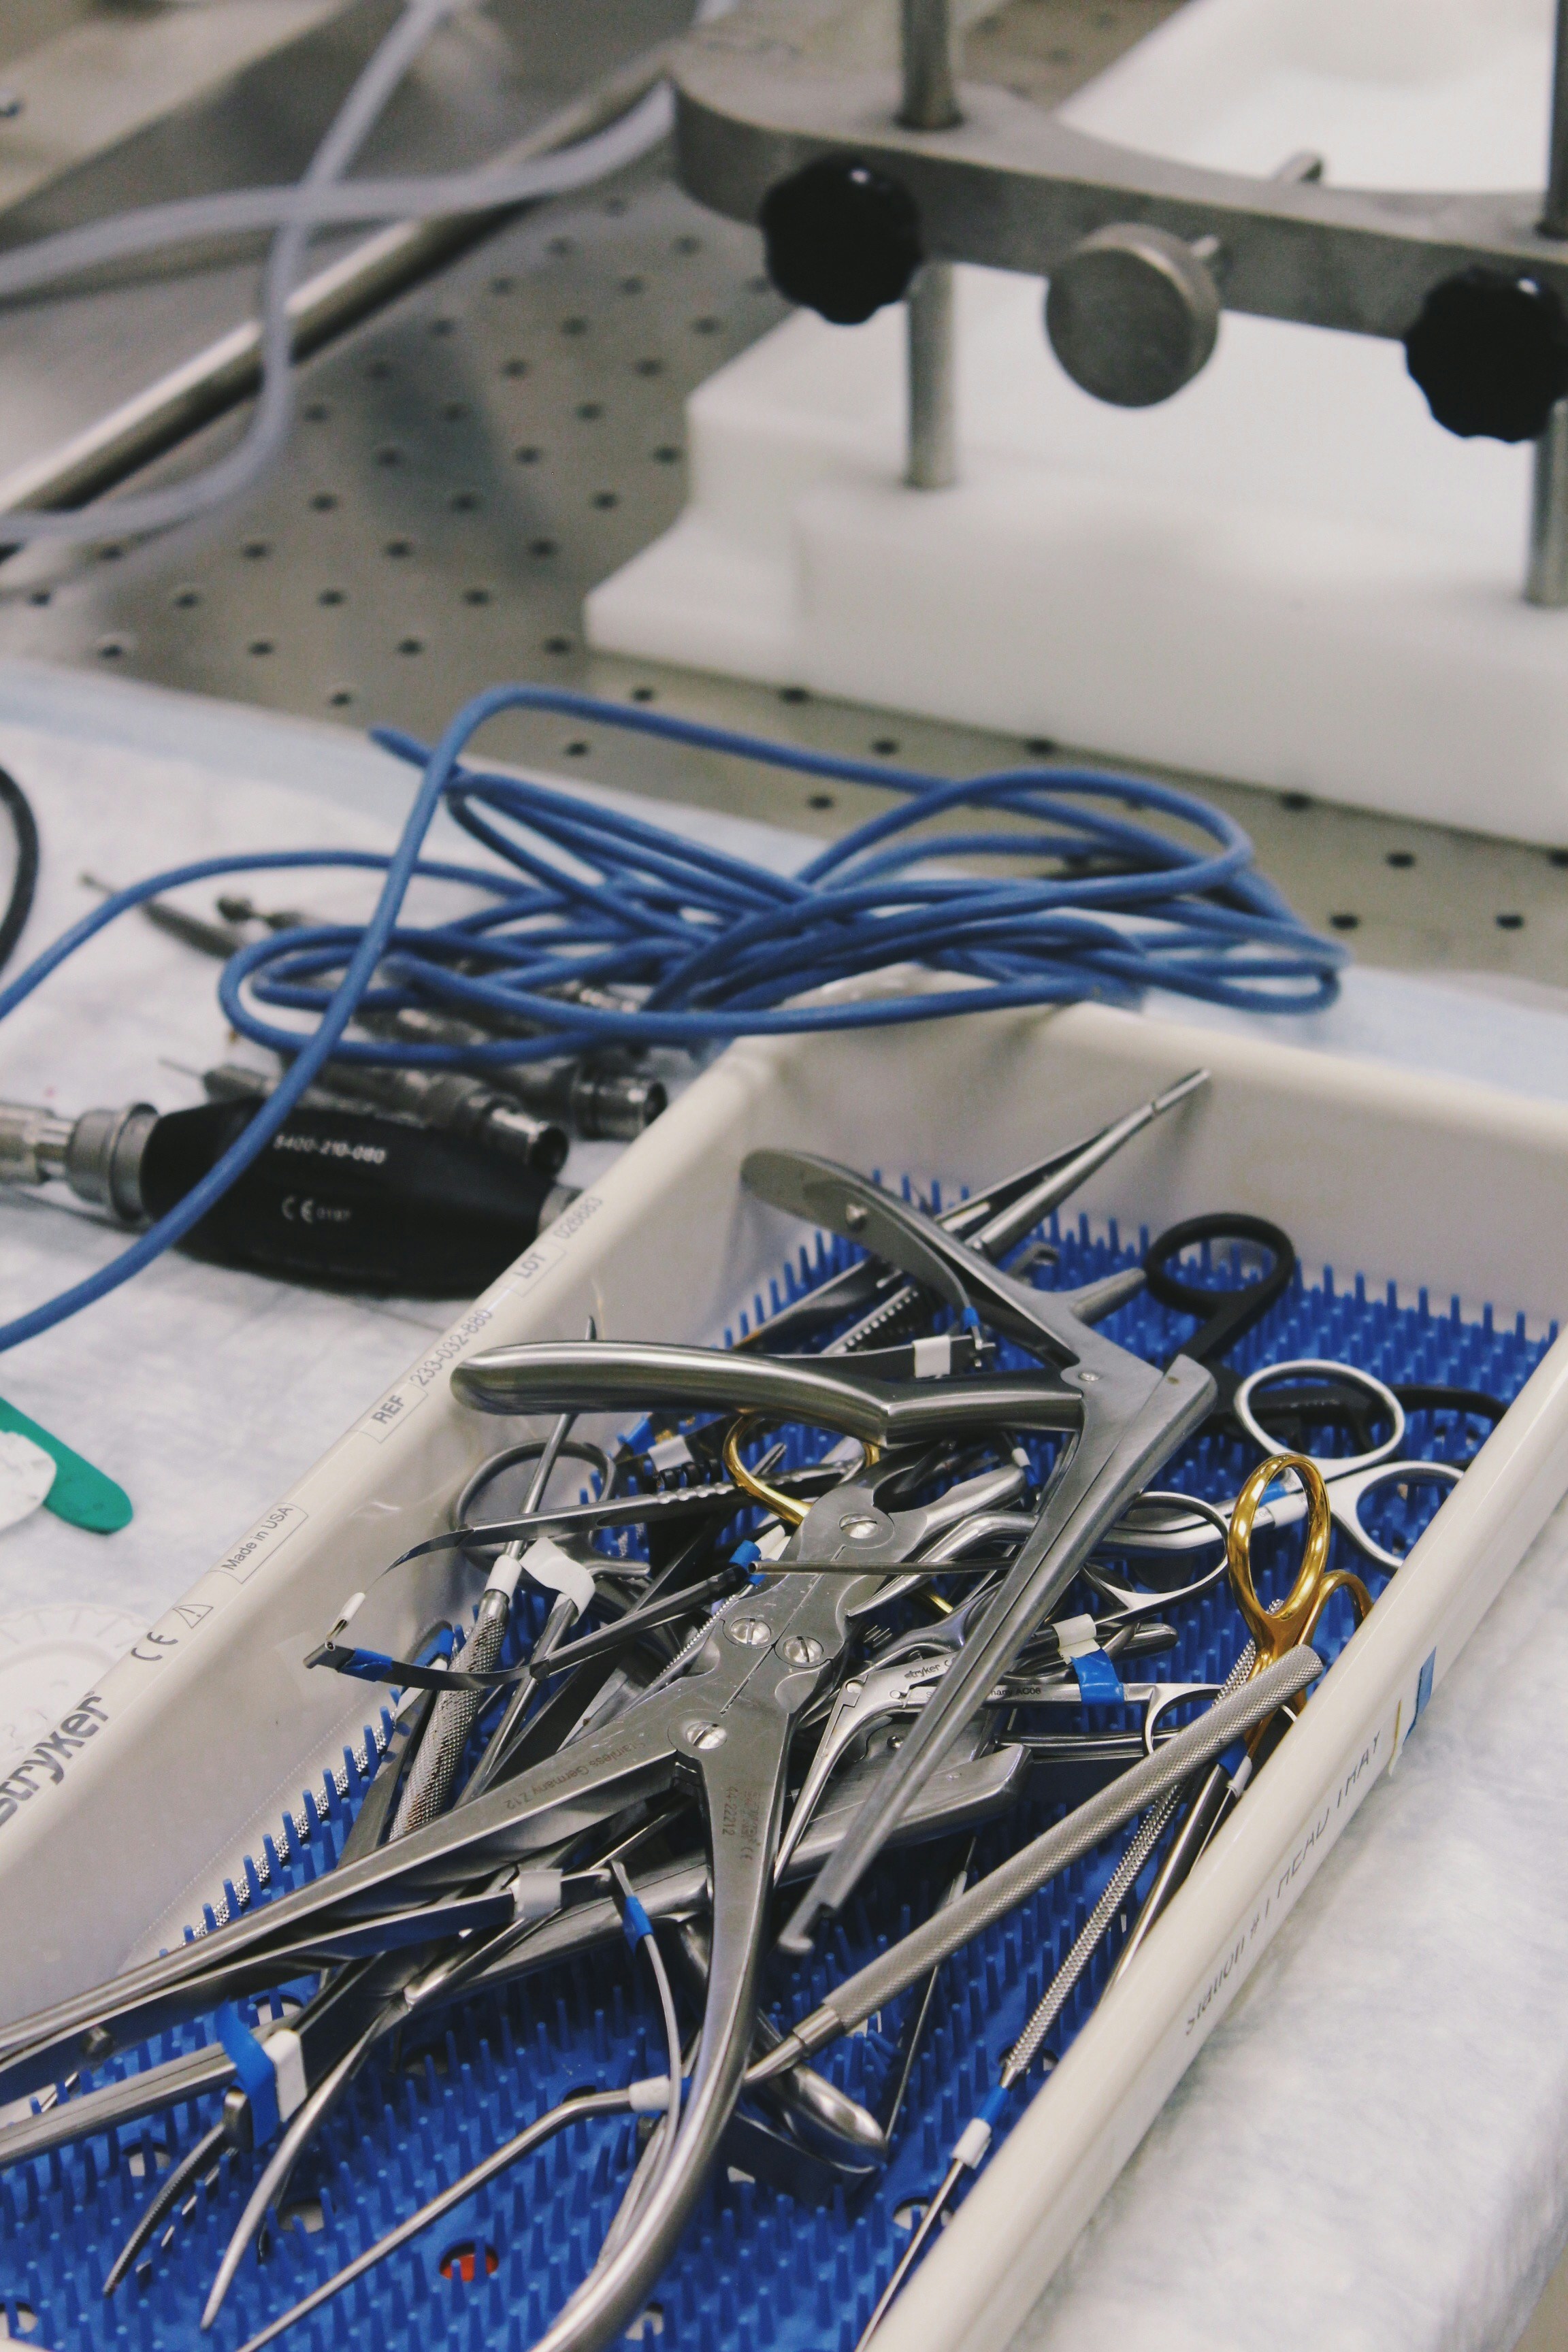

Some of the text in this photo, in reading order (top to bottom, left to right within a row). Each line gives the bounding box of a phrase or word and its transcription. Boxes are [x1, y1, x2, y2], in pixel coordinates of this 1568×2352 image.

[515, 1252, 547, 1279] LOT
[371, 1395, 406, 1425] REF
[221, 1507, 294, 1571] Made in USA
[531, 1765, 589, 1795] Germany
